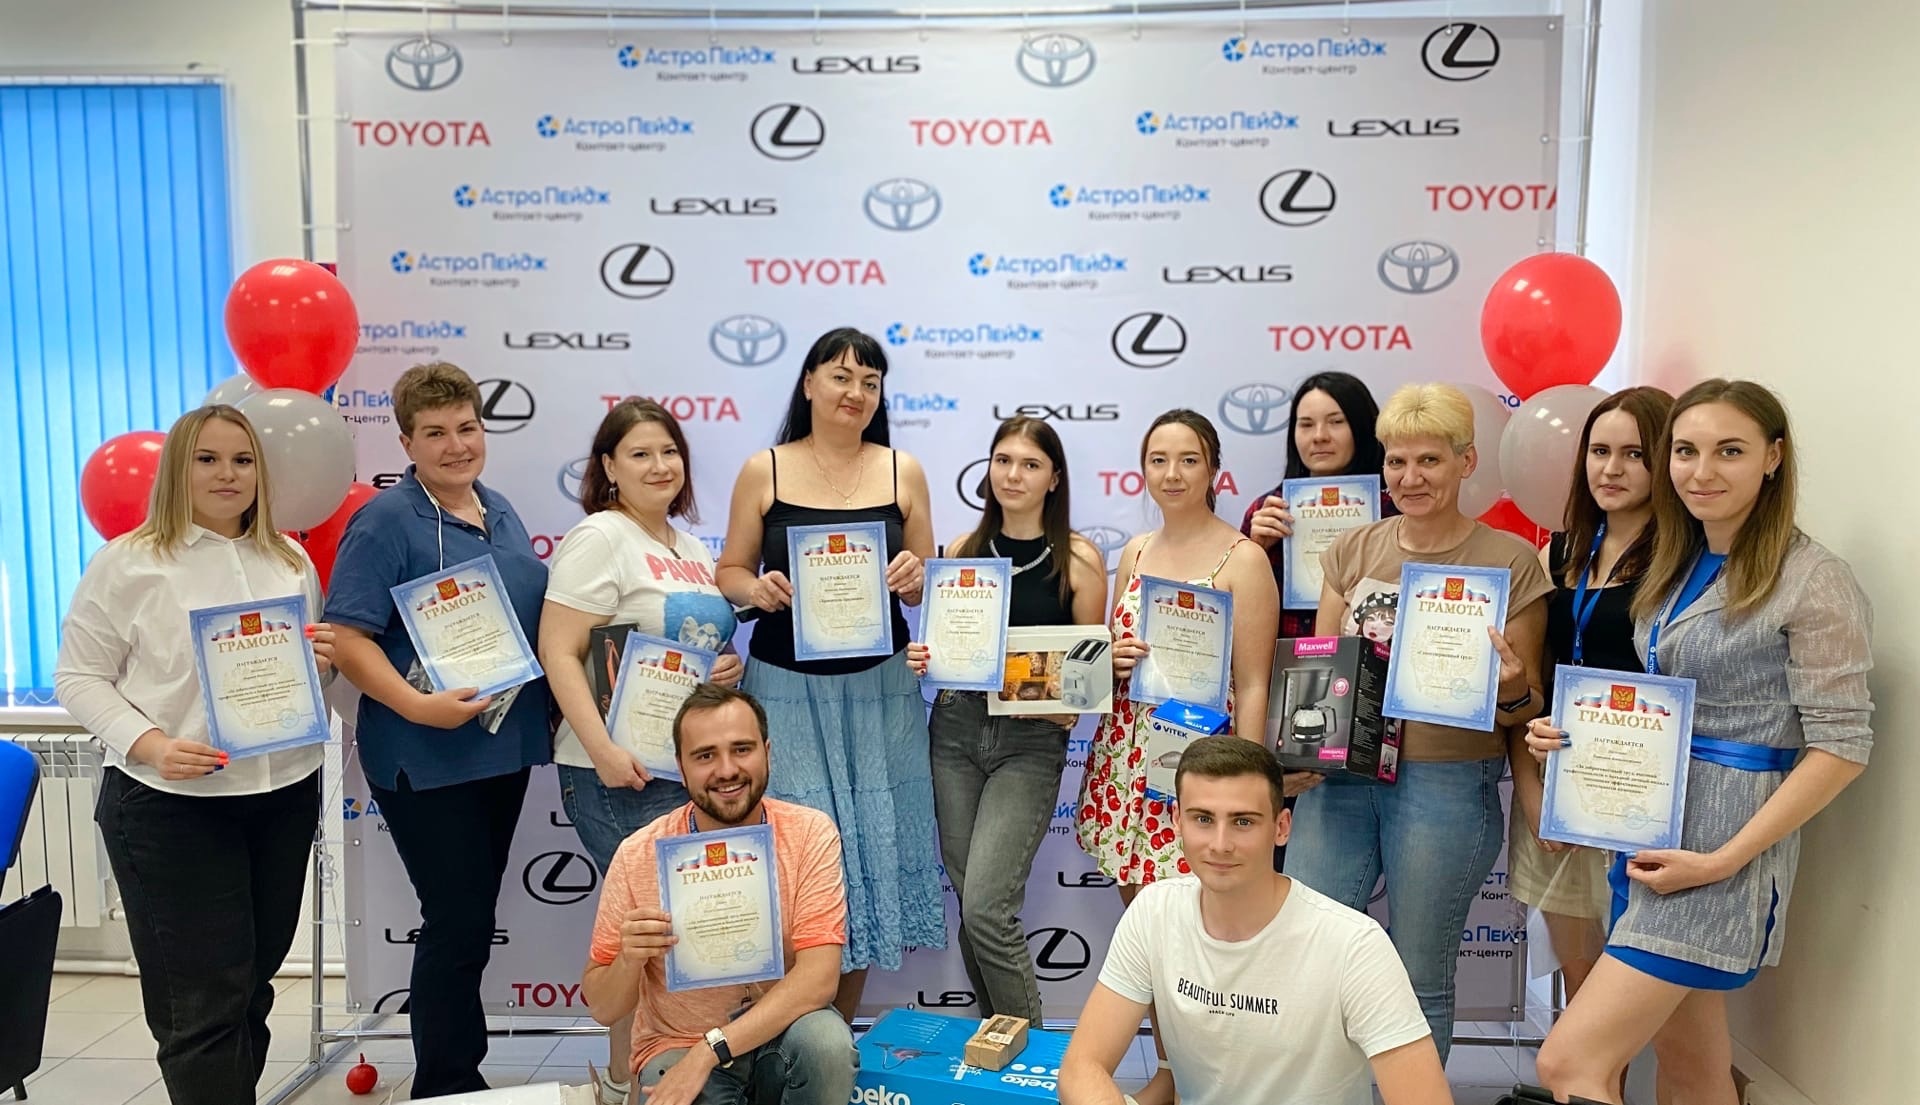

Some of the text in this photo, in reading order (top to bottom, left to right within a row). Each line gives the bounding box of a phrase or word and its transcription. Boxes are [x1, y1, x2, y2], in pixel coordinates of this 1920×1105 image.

[792, 57, 920, 74] LEXUS
[352, 121, 491, 146] TOYOTA
[910, 120, 1052, 145] TOYOTA
[1328, 119, 1460, 136] LEXUS
[651, 198, 777, 215] LEXUS
[745, 259, 886, 285] TOYOTA
[1163, 266, 1293, 283] LEXUS
[504, 333, 631, 350] LEXUS
[1269, 326, 1413, 351] TOYOTA
[1302, 508, 1361, 519] ГРАМОТА
[644, 552, 717, 587] PAWS
[809, 555, 869, 567] ГРАМОТА
[940, 588, 993, 600] ГРАМОТА
[424, 591, 486, 620] ГРАМОТА
[1418, 601, 1485, 617] ГРАМОТА
[1158, 605, 1215, 624] ГРАМОТА
[218, 633, 289, 653] ГРАМОТА
[1298, 641, 1334, 652] Maxwell
[1578, 710, 1664, 732] ГРАМОТА
[1163, 726, 1188, 739] VITEK
[682, 865, 755, 885] ГРАМОТА
[1177, 977, 1279, 1015] BEAUTIFUL SUMMER
[1000, 1075, 1057, 1091] beko
